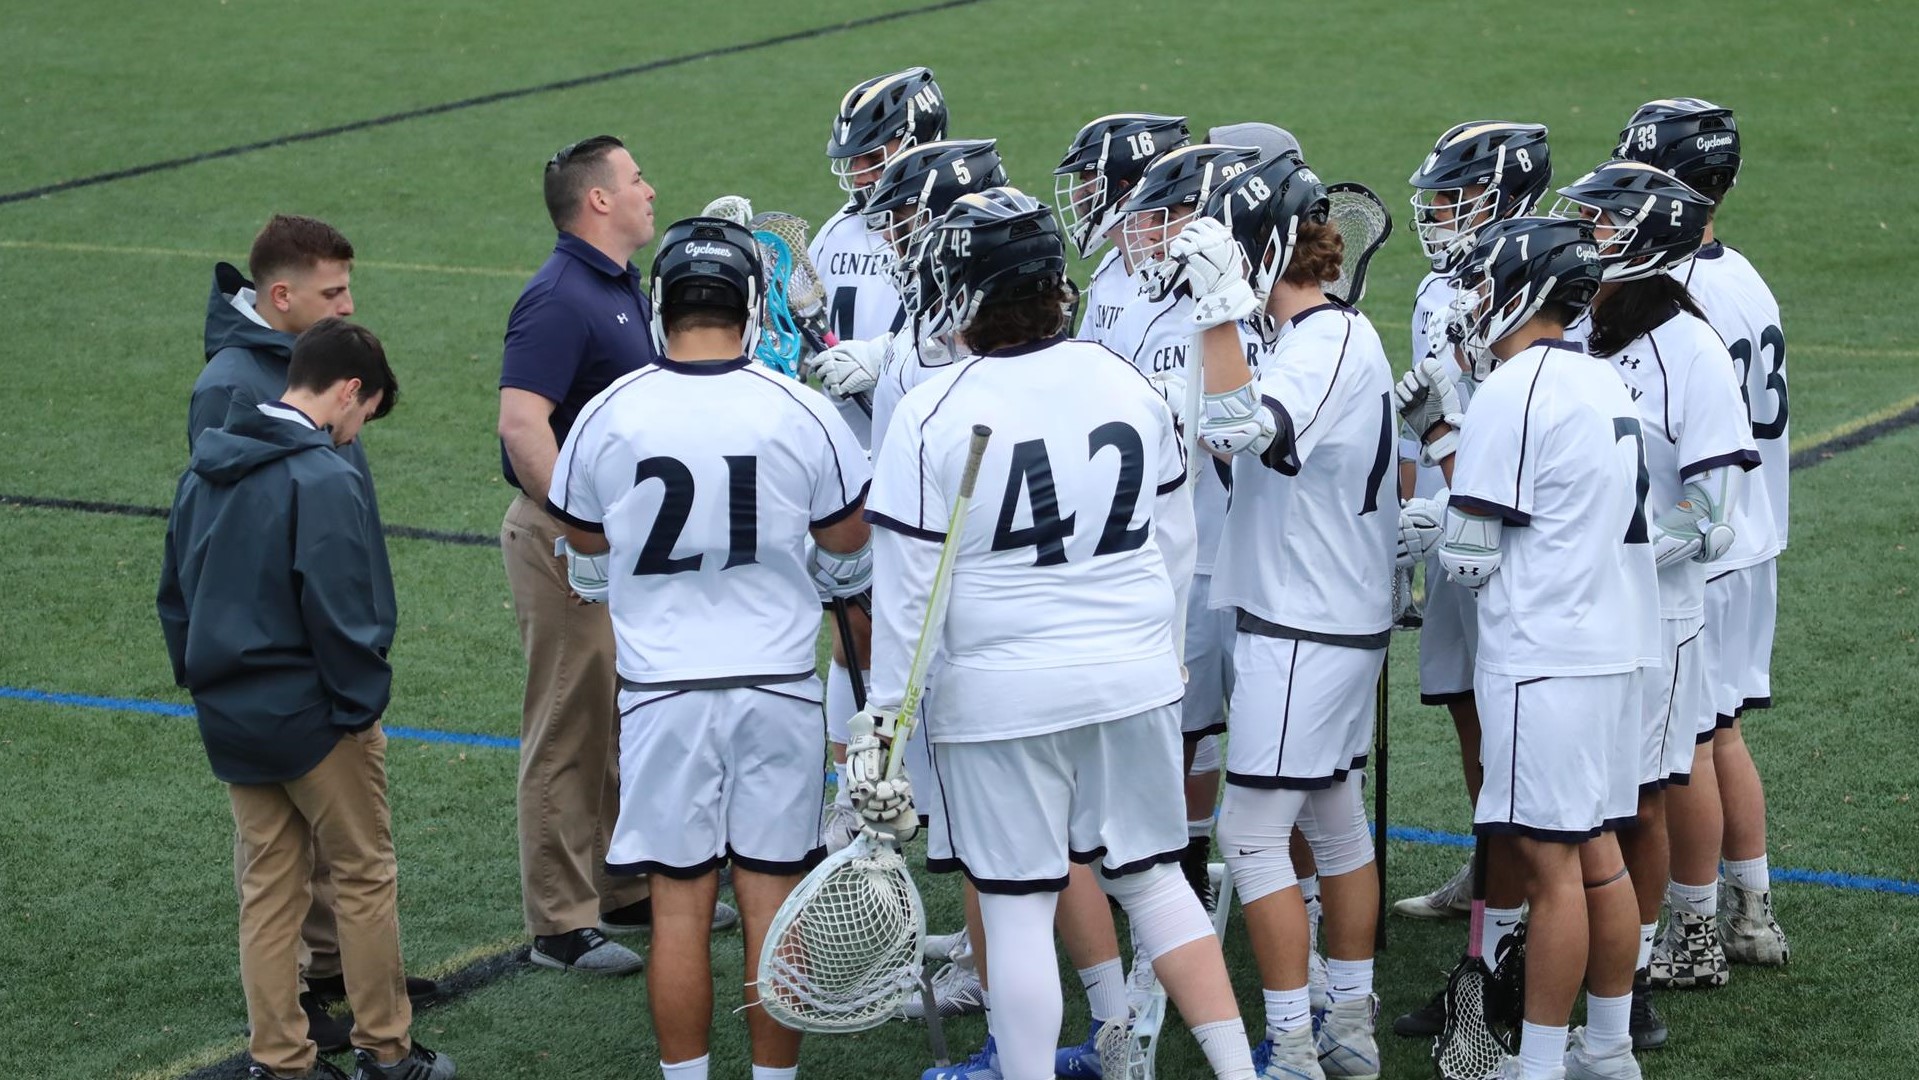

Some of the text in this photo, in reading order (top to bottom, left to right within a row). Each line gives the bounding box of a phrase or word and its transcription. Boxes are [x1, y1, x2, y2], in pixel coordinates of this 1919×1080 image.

[914, 85, 941, 113] 44
[1126, 130, 1156, 161] 16
[1637, 124, 1657, 151] 33
[951, 158, 972, 186] 5
[1515, 148, 1533, 173] 8
[1237, 176, 1271, 211] 18
[1670, 200, 1683, 227] 2
[684, 242, 732, 257] Cyclones
[951, 229, 971, 257] 42
[1516, 234, 1529, 261] 7
[991, 421, 1151, 567] 42
[1612, 416, 1650, 544] 7
[632, 455, 759, 576] 21
